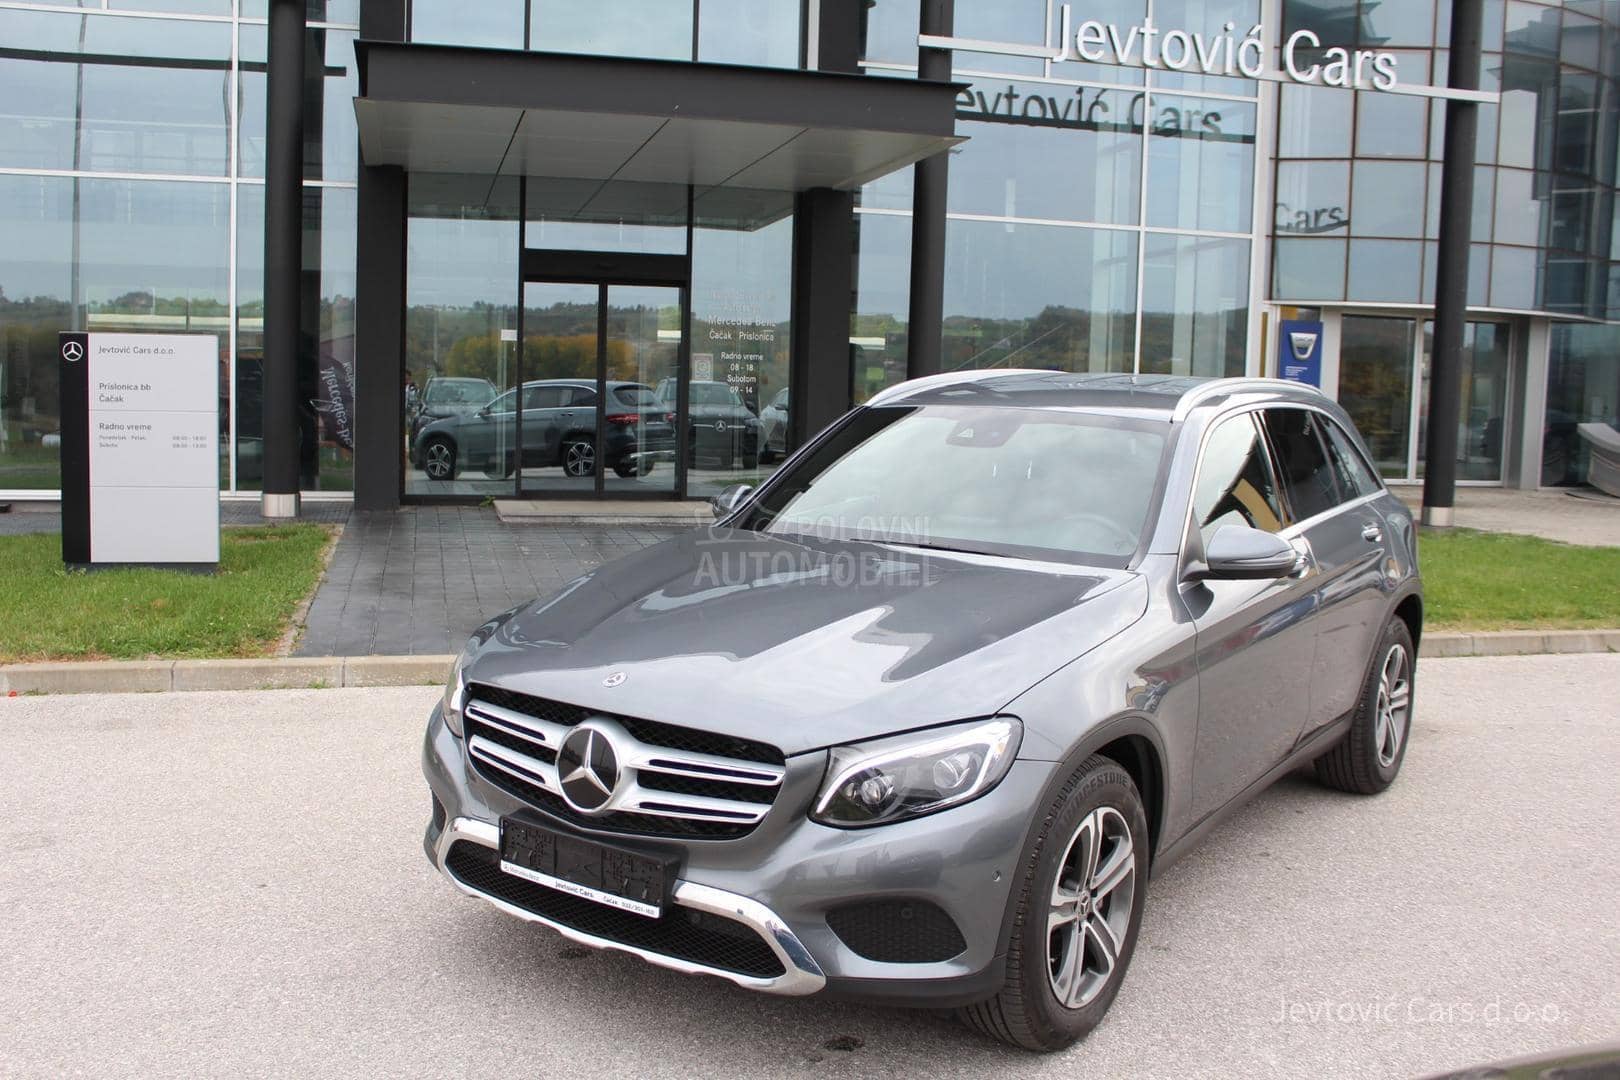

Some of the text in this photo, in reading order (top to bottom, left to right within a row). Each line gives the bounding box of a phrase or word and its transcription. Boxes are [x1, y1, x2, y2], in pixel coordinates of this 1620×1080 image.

[1051, 4, 1398, 92] Jevtović Cars
[954, 86, 1109, 126] evtović
[739, 332, 774, 341] Prislonica
[98, 346, 131, 354] Jevtović
[133, 346, 151, 354] Cars
[721, 351, 741, 360] Radno
[730, 363, 739, 371] 08
[727, 374, 756, 382] Subotom
[99, 383, 138, 391] Prislonica
[99, 394, 124, 403] Čačak
[99, 422, 125, 431] Radno
